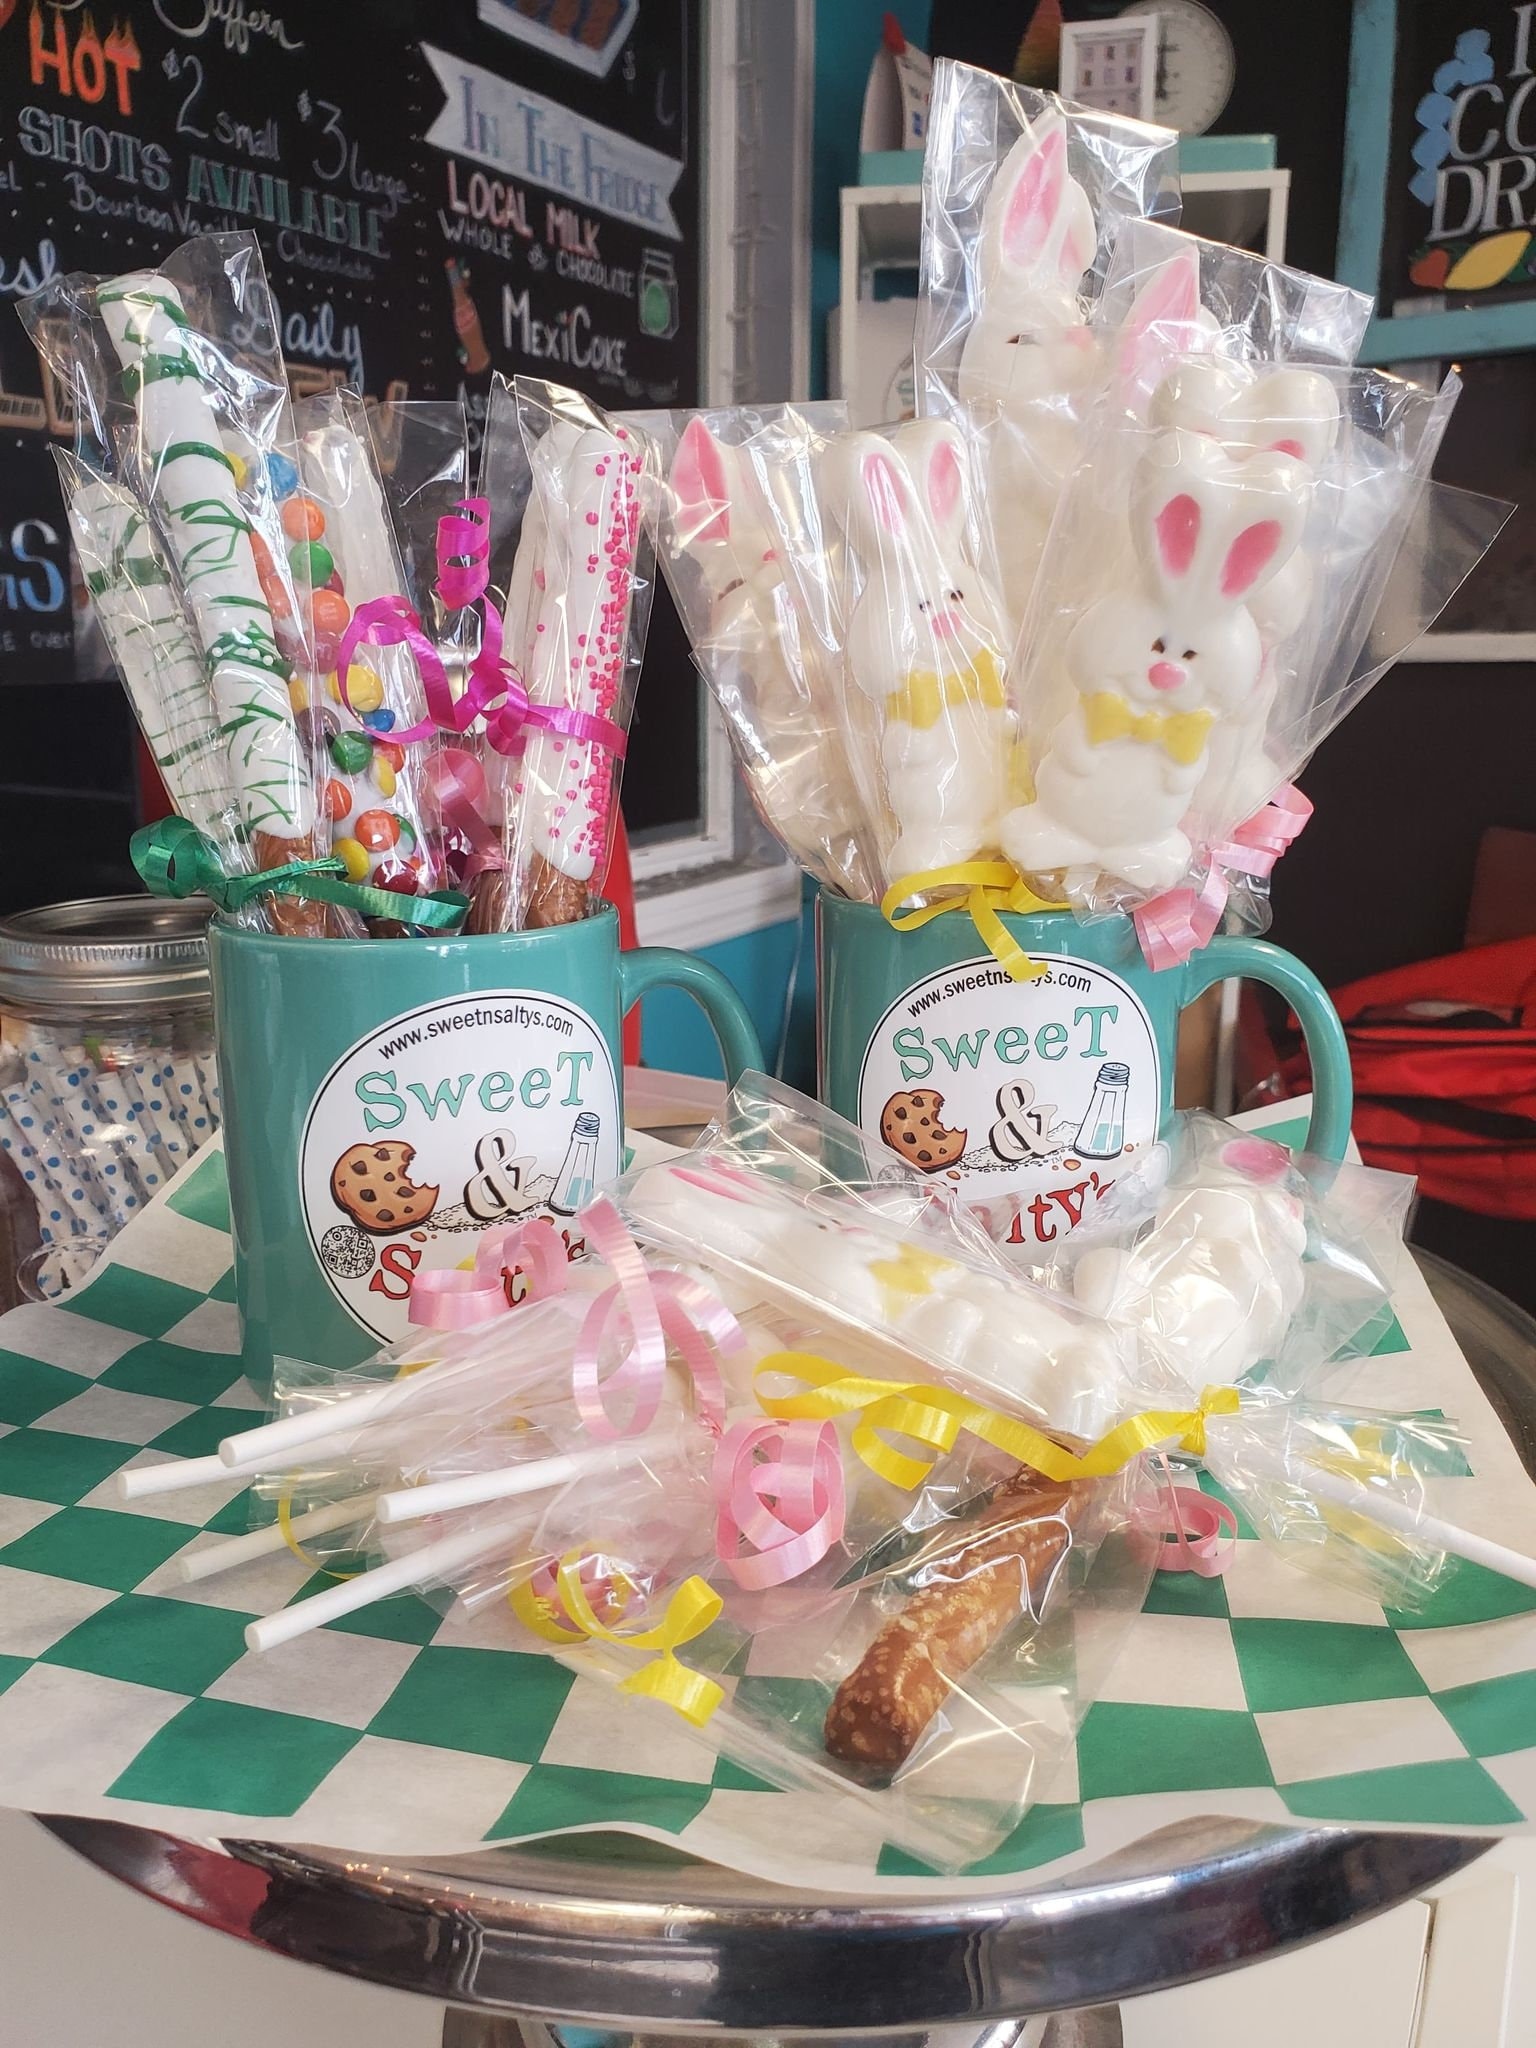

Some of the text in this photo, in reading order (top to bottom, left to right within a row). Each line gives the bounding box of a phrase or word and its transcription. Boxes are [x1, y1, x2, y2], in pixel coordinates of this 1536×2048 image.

[30, 0, 141, 116] HOT
[214, 111, 280, 161] Small
[18, 105, 391, 260] SHOTS AVAILABLE
[446, 160, 600, 260] LOCAL MILK
[438, 208, 512, 260] WHOLE
[556, 249, 635, 298] CHOCOLATE
[378, 1004, 574, 1060] www.sweetnsaltys.com
[989, 1078, 1058, 1163] &
[463, 1128, 537, 1221] &
